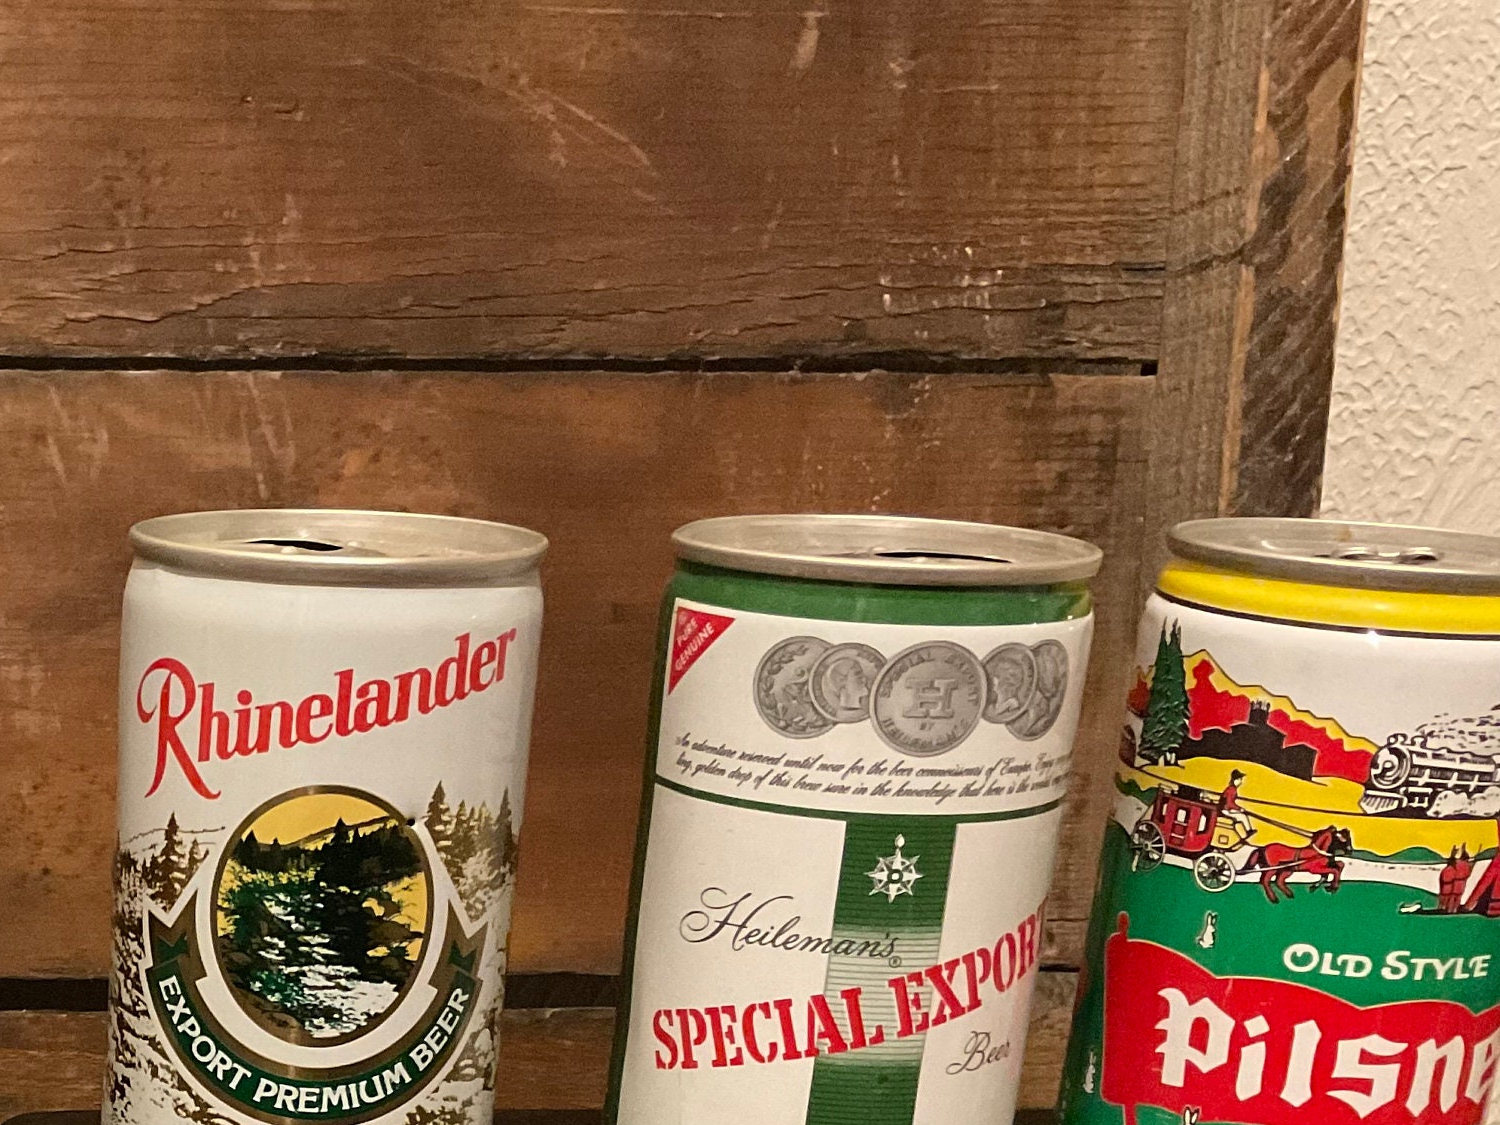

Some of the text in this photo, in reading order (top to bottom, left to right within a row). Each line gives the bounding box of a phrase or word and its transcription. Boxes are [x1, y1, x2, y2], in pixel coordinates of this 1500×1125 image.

[675, 622, 715, 671] GENUINE
[136, 627, 518, 801] Rhinelander
[691, 739, 738, 758] adventure
[737, 752, 788, 765] reserved
[783, 754, 825, 769] until
[816, 763, 846, 772] now
[841, 757, 865, 780] for
[866, 758, 888, 775] the
[888, 760, 914, 776] beer
[691, 759, 727, 777] golden
[728, 766, 752, 787] drop
[753, 768, 774, 790] of
[769, 771, 792, 788] this
[793, 774, 822, 791] brew
[852, 783, 868, 795] in
[870, 780, 892, 796] the
[892, 780, 957, 805] knowledge
[678, 886, 901, 960] Heileman's
[1381, 950, 1492, 981] STYLE
[158, 974, 470, 1114] EXPORT PREMIUM BEER
[652, 986, 885, 1071] SPECIAL
[946, 1030, 1011, 1076] Beer
